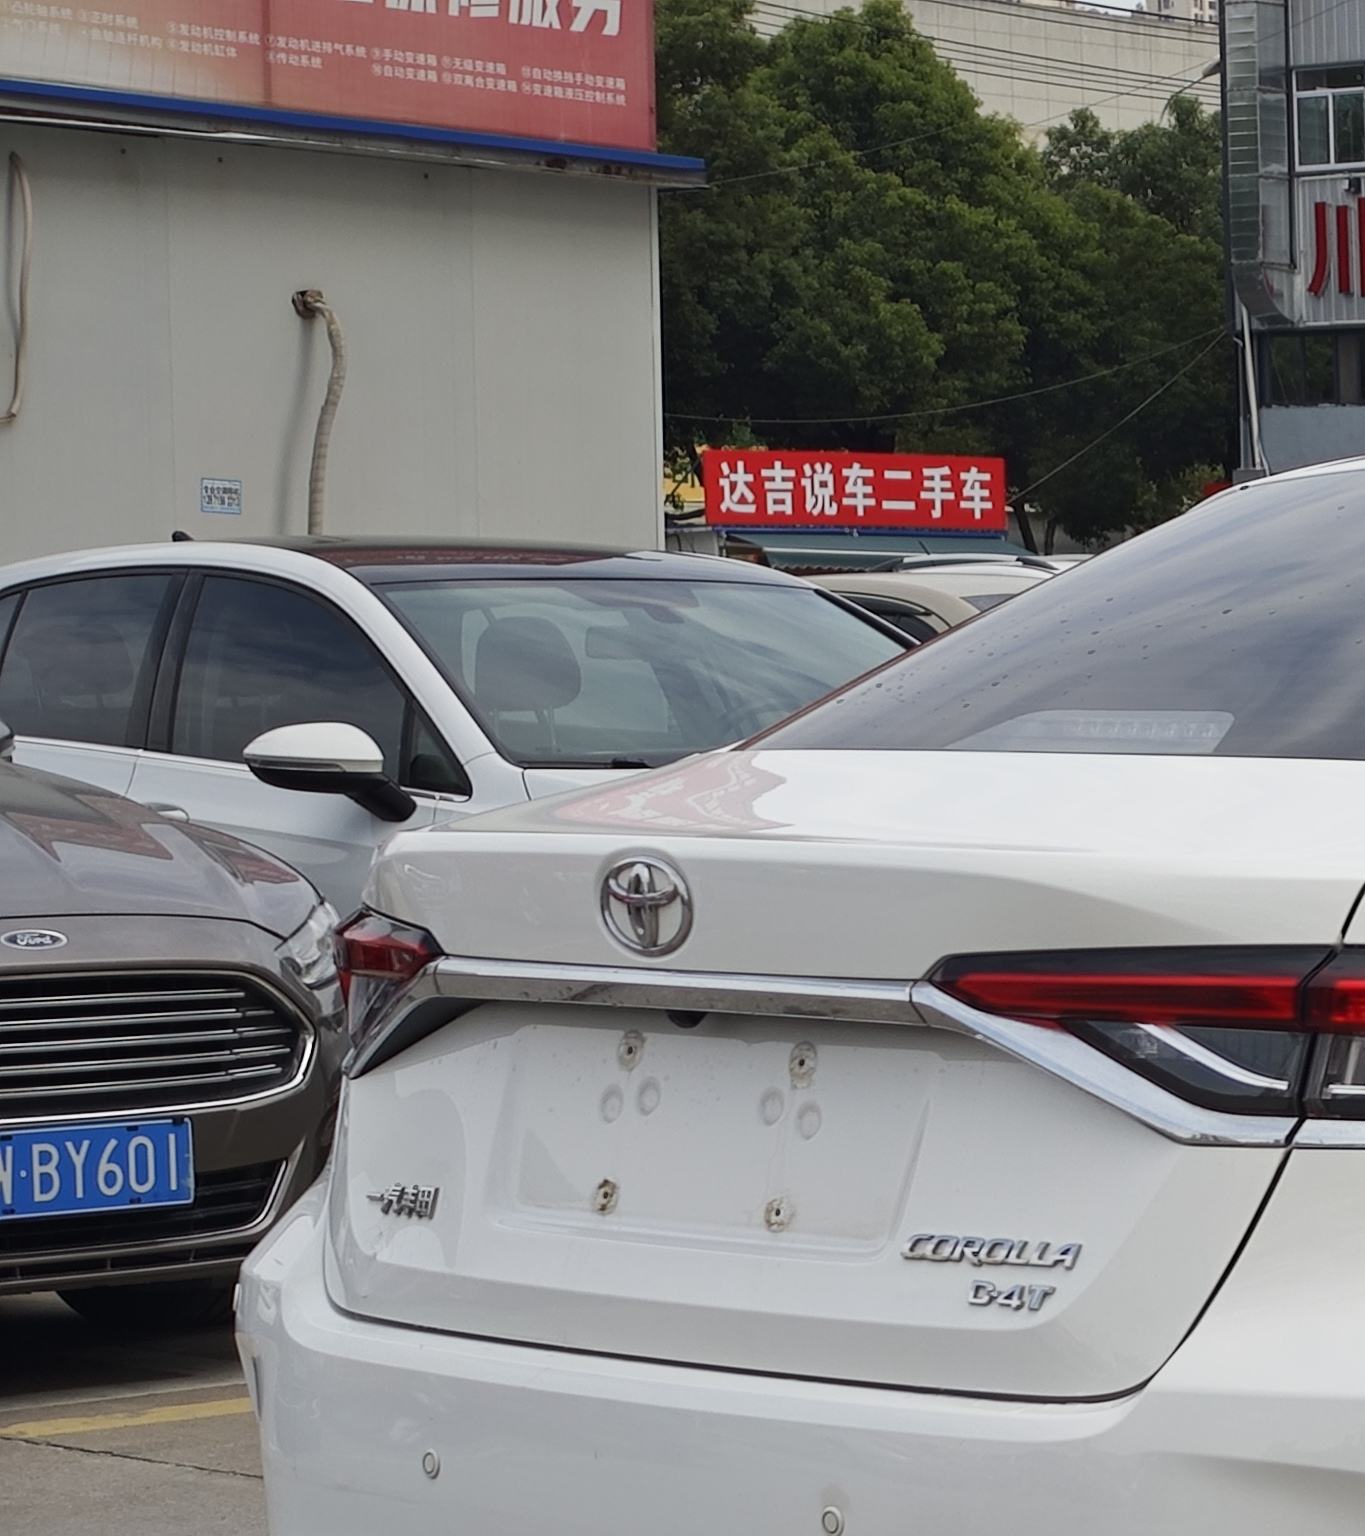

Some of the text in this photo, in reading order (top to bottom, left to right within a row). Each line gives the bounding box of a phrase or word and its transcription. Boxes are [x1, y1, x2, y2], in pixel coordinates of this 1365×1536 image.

[718, 460, 993, 519] 达吉说车二手车
[901, 1233, 1082, 1270] COROLLA
